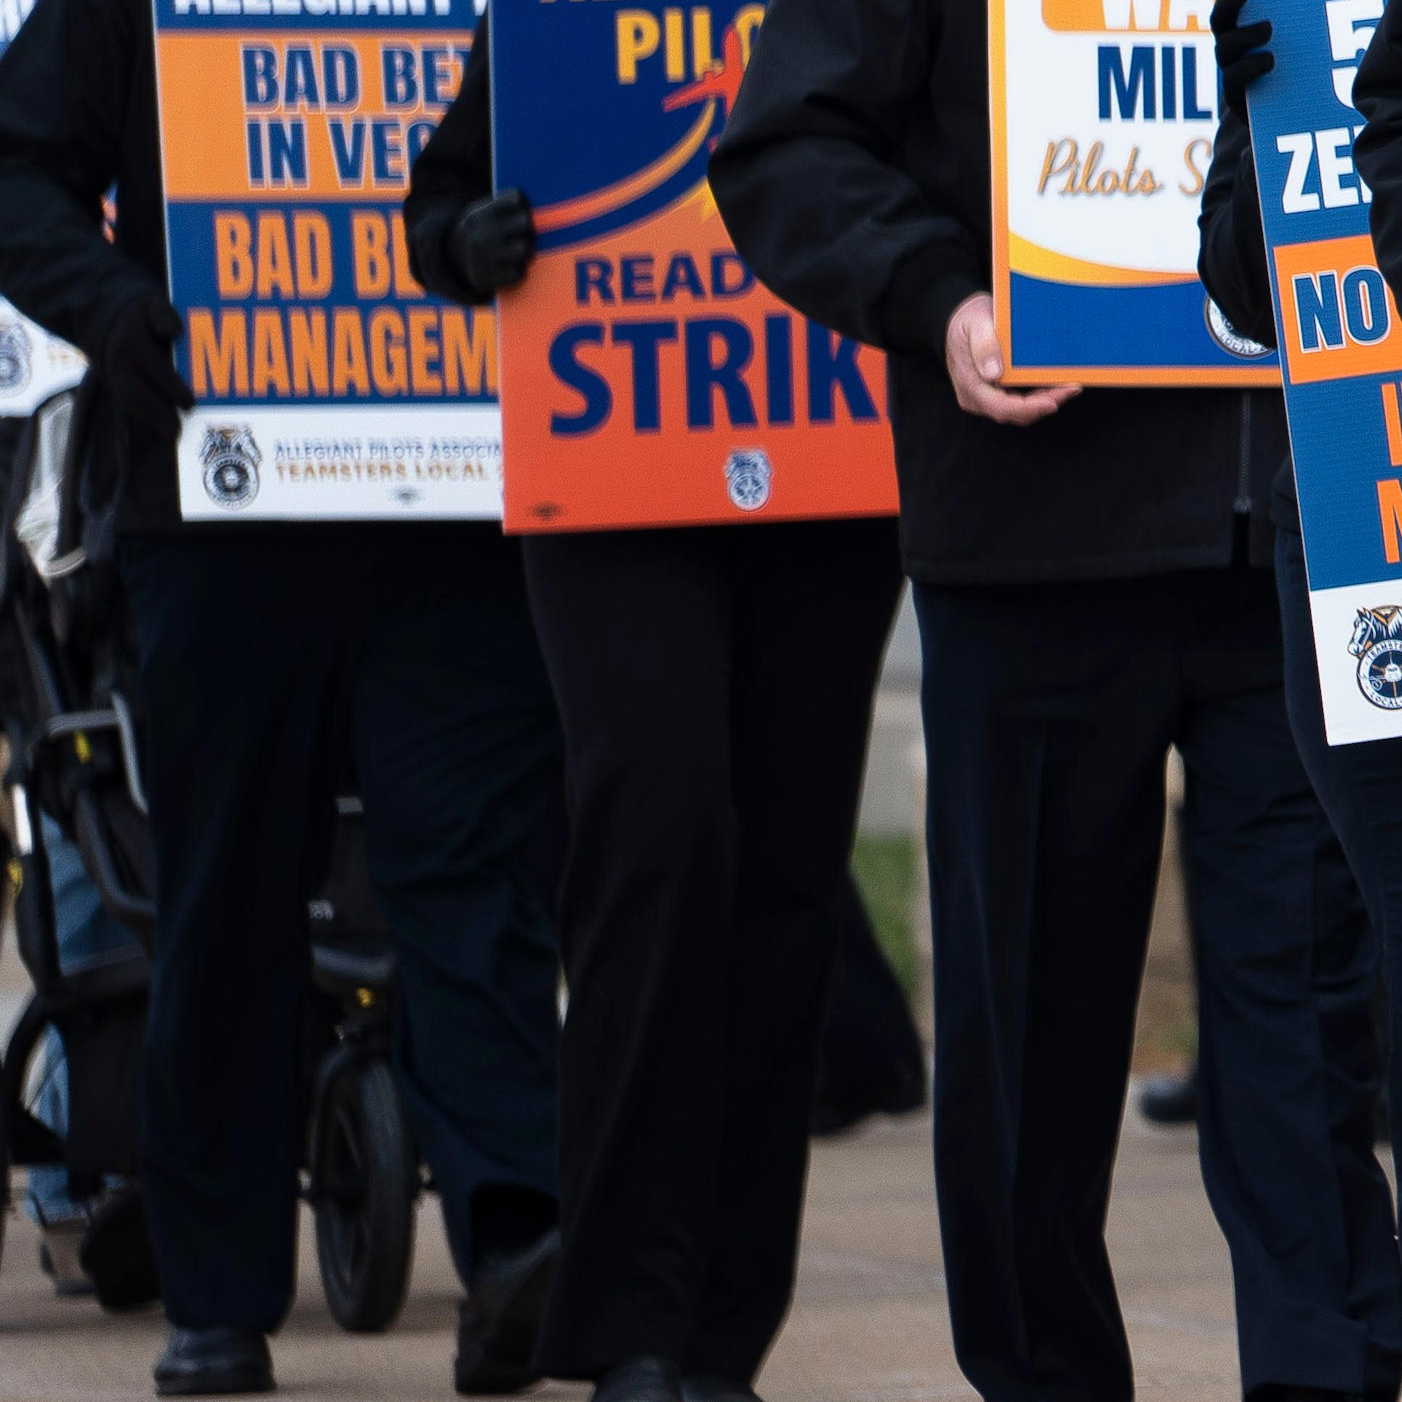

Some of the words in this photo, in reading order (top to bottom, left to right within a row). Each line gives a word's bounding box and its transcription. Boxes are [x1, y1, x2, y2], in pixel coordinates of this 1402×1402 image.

[240, 38, 362, 115] BAD
[1096, 44, 1222, 121] MIL
[246, 115, 310, 191] IN
[1036, 137, 1166, 198] Pilots
[1276, 126, 1373, 215] ZE
[213, 208, 333, 300] BAD
[575, 248, 758, 307] READ
[1291, 264, 1392, 354] NO
[187, 306, 500, 398] MANAGEM
[548, 308, 882, 441] STRIK
[429, 436, 501, 461] ASSOCIA
